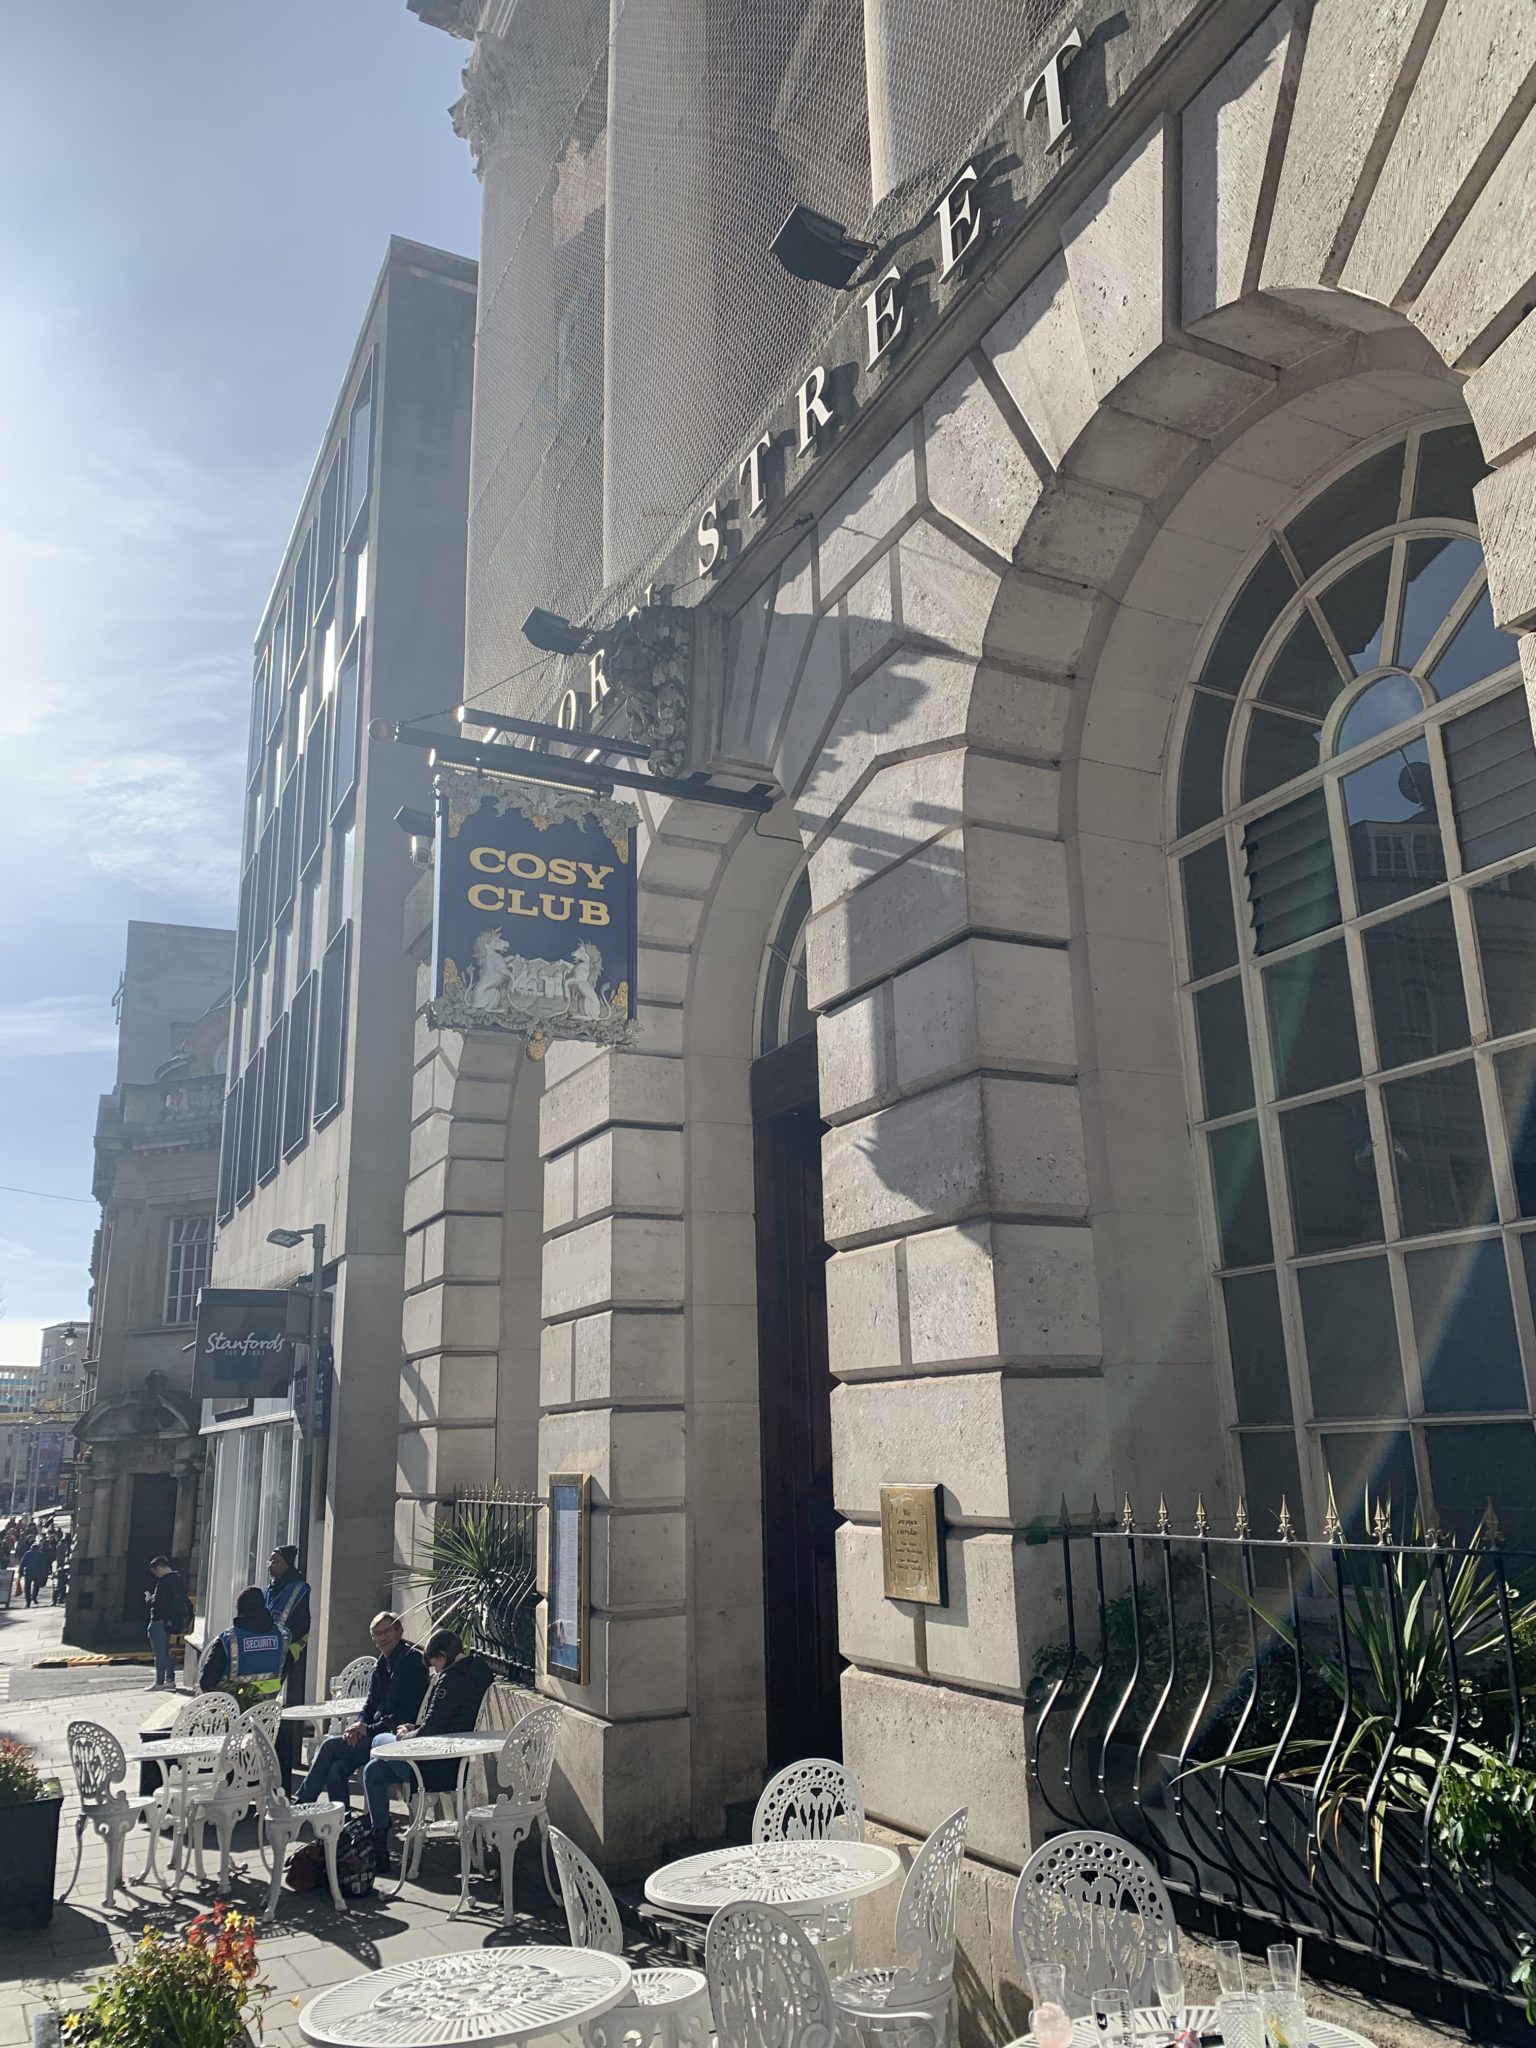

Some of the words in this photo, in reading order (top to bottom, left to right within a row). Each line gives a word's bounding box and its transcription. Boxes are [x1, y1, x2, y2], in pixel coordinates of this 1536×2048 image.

[697, 27, 1083, 578] STREET
[468, 846, 615, 891] COSY
[467, 883, 612, 927] CLUB
[204, 1331, 286, 1357] Stanfords
[246, 1638, 277, 1649] SECURITY
